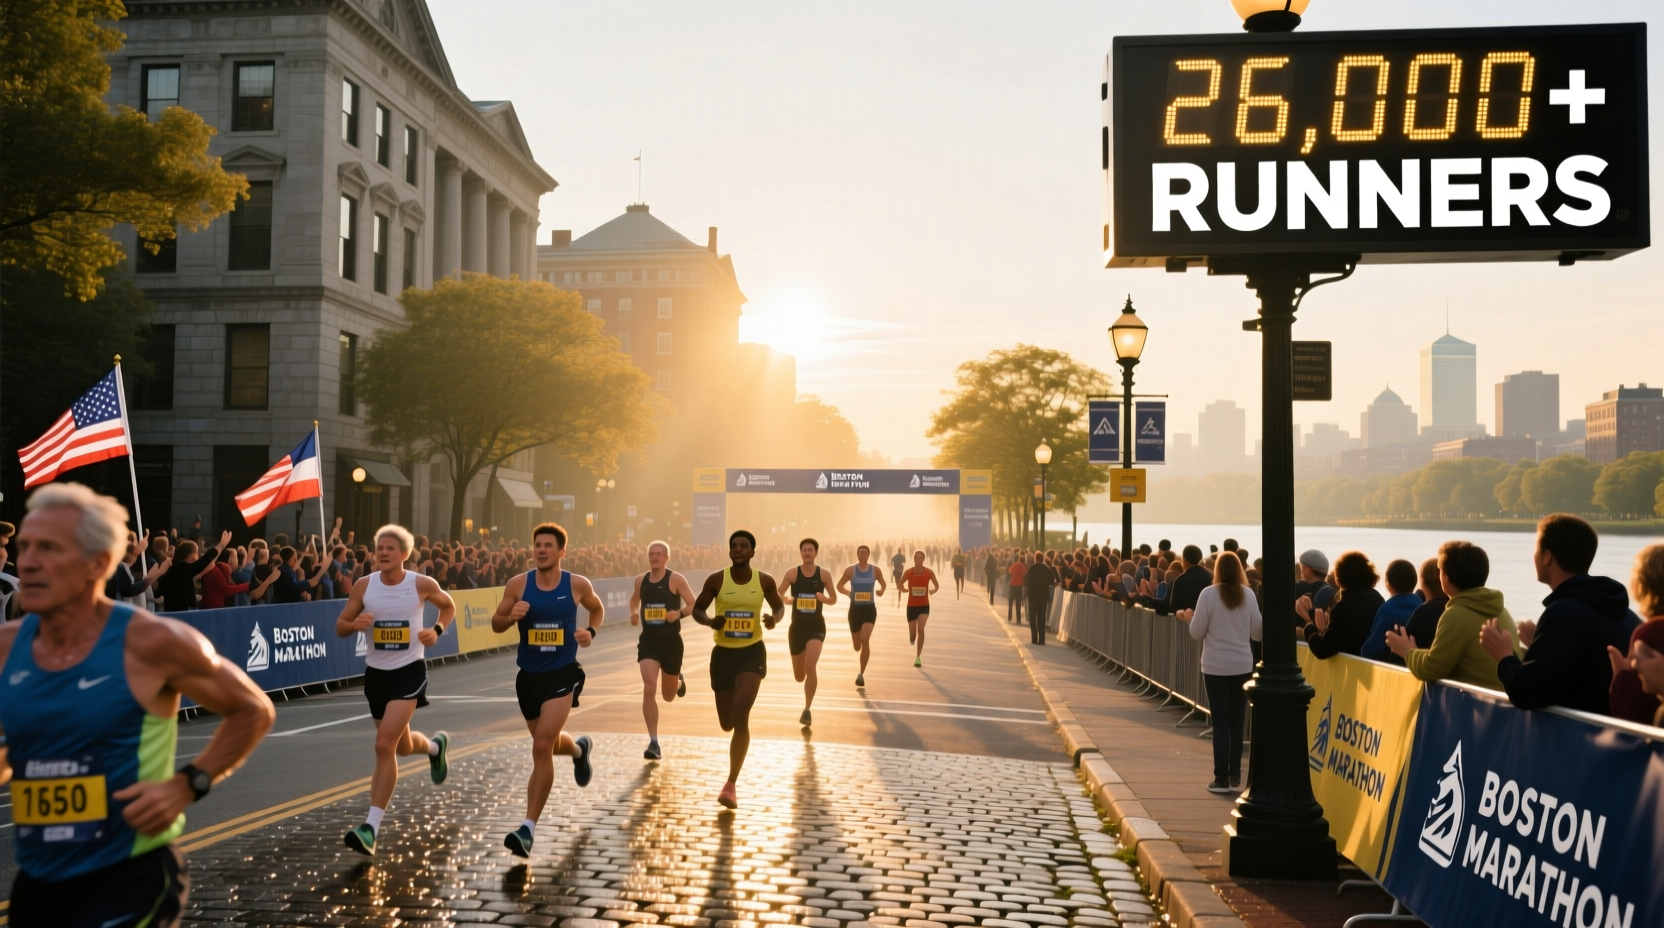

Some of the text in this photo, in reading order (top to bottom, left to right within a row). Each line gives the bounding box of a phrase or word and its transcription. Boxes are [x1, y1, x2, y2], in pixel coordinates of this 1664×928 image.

[1151, 154, 1612, 233] RUNNERS
[273, 624, 315, 645] BOSTON
[1335, 713, 1383, 758] BOSTON
[22, 783, 88, 818] 1650
[1327, 746, 1386, 803] MARATHON
[1478, 769, 1607, 870] BOSTON
[1461, 823, 1635, 928] MARATHON
